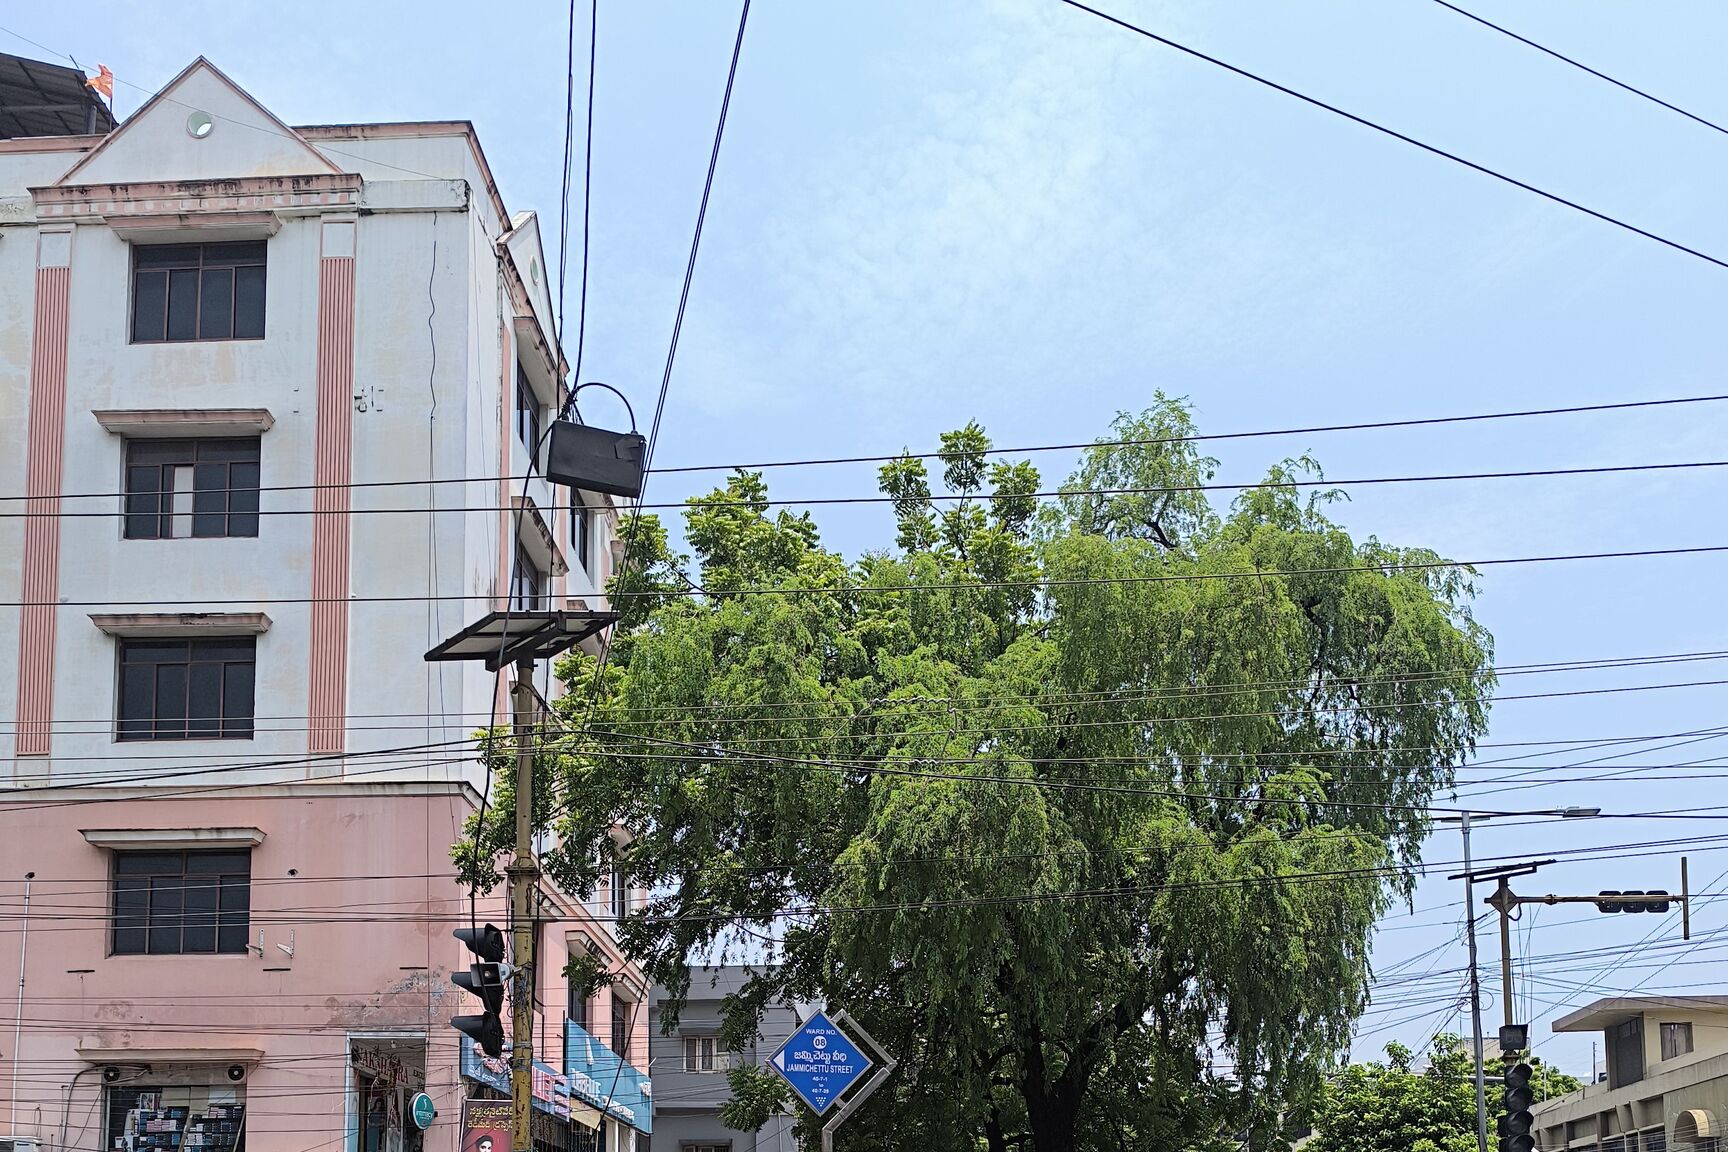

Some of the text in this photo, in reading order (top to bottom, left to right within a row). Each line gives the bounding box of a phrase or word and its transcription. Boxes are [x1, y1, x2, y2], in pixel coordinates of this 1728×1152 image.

[814, 1038, 826, 1047] 08
[786, 1063, 854, 1074] JAMMICHETTU STREET
